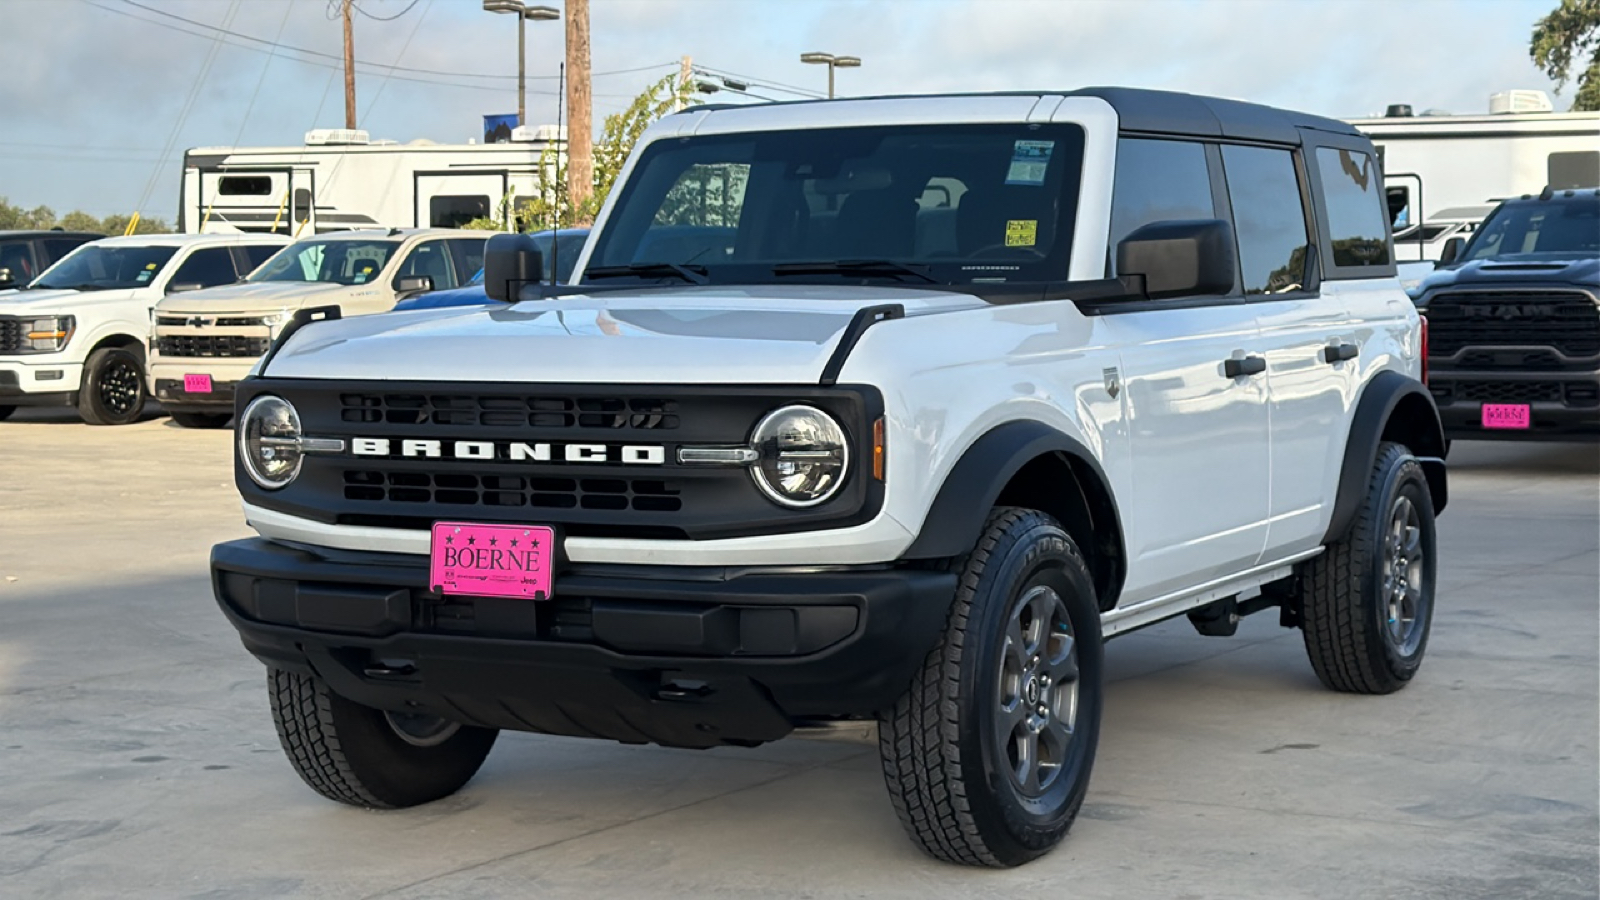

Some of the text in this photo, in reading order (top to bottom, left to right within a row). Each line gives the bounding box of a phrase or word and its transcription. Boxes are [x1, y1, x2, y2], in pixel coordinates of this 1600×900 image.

[1460, 304, 1555, 318] RAM
[352, 438, 665, 464] BRONCO
[444, 546, 540, 572] BOERNE
[521, 576, 537, 585] Jeep
